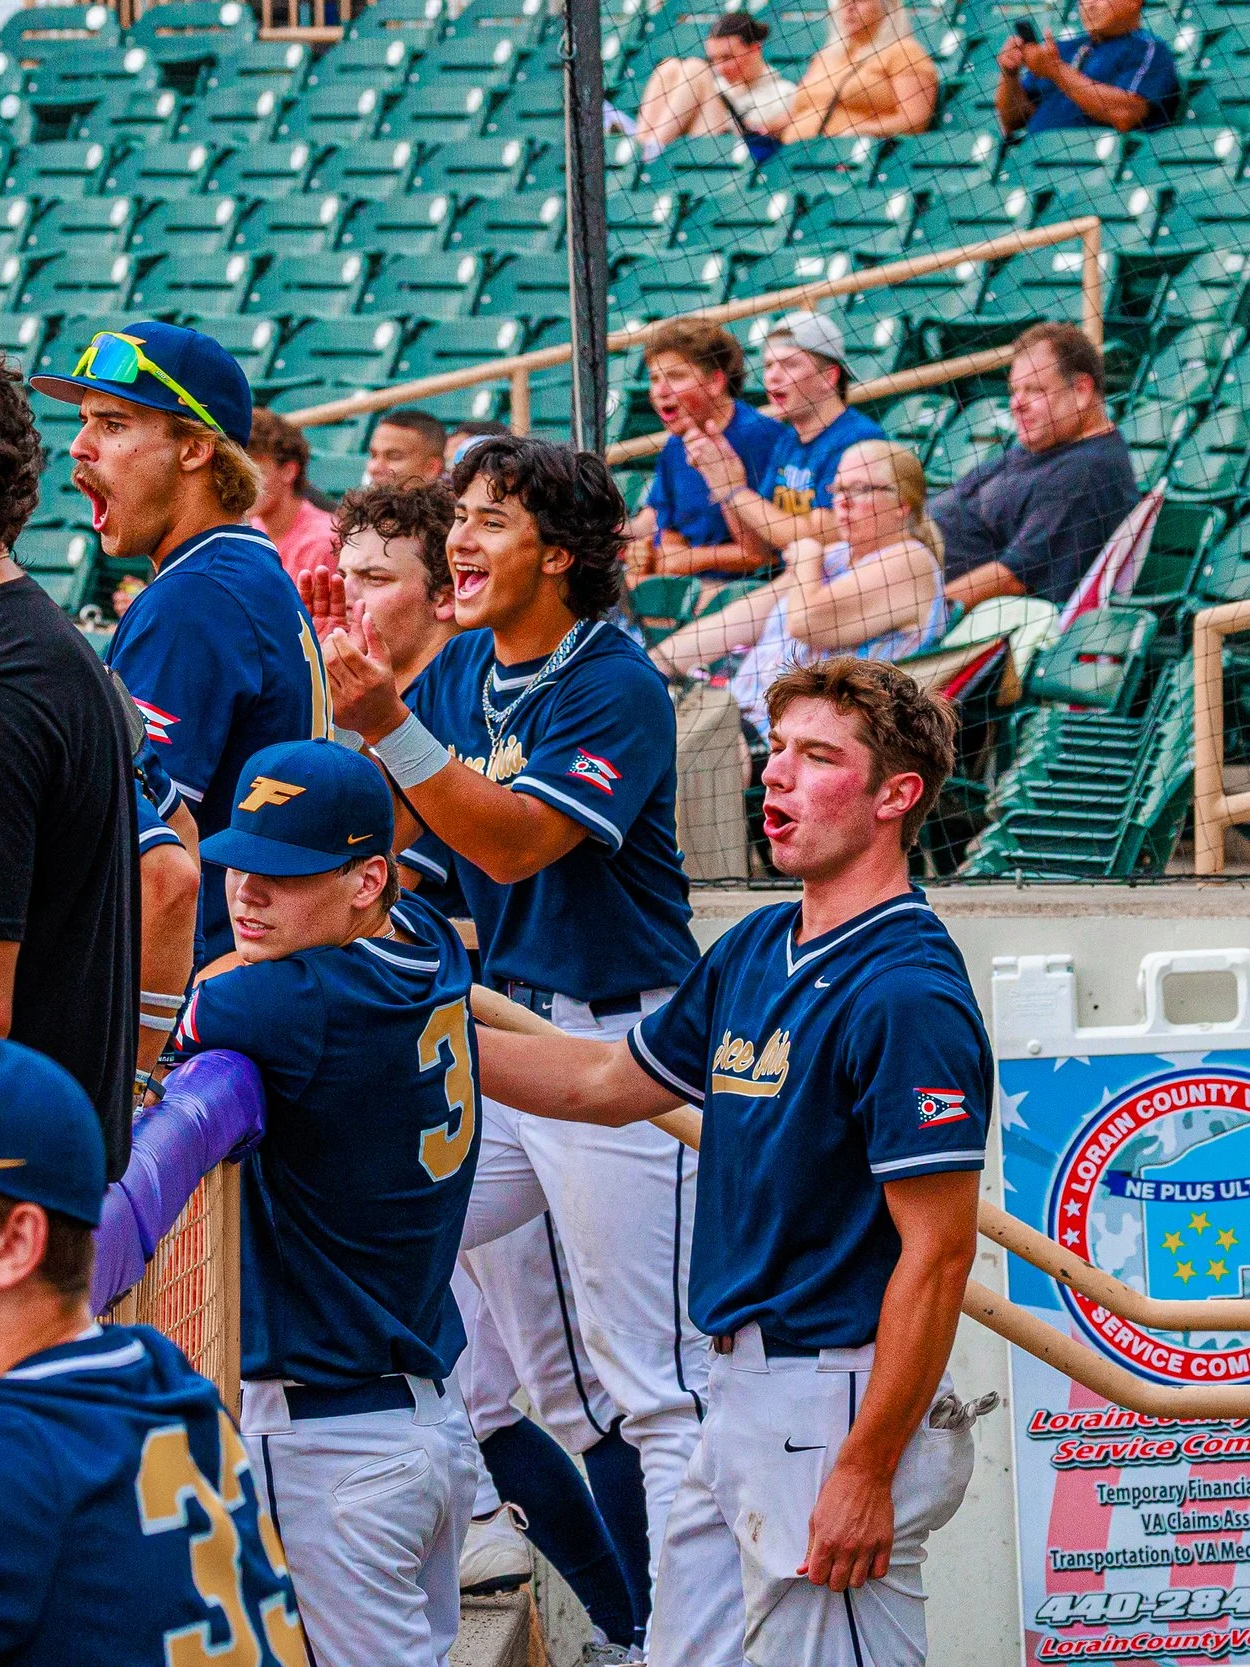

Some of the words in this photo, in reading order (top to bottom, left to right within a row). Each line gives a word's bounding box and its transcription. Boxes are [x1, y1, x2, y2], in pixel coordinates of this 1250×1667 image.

[417, 996, 475, 1182] 3
[1071, 1112, 1136, 1193] LORAIN
[1136, 1083, 1239, 1119] COUNTY
[1125, 1180, 1156, 1199] NE
[1160, 1183, 1216, 1201] PLUS
[1091, 1306, 1184, 1374] SERVICE
[1190, 1352, 1250, 1377] COM
[1053, 1437, 1175, 1463] Service
[1097, 1483, 1184, 1506] Temporary
[1141, 1513, 1163, 1531] VA
[1167, 1510, 1220, 1529] Claims
[1223, 1509, 1250, 1527] Ass
[1051, 1545, 1171, 1573] Transportation
[1175, 1547, 1191, 1561] to
[1195, 1542, 1220, 1560] VA
[1040, 1629, 1250, 1657] LorainCountyV
